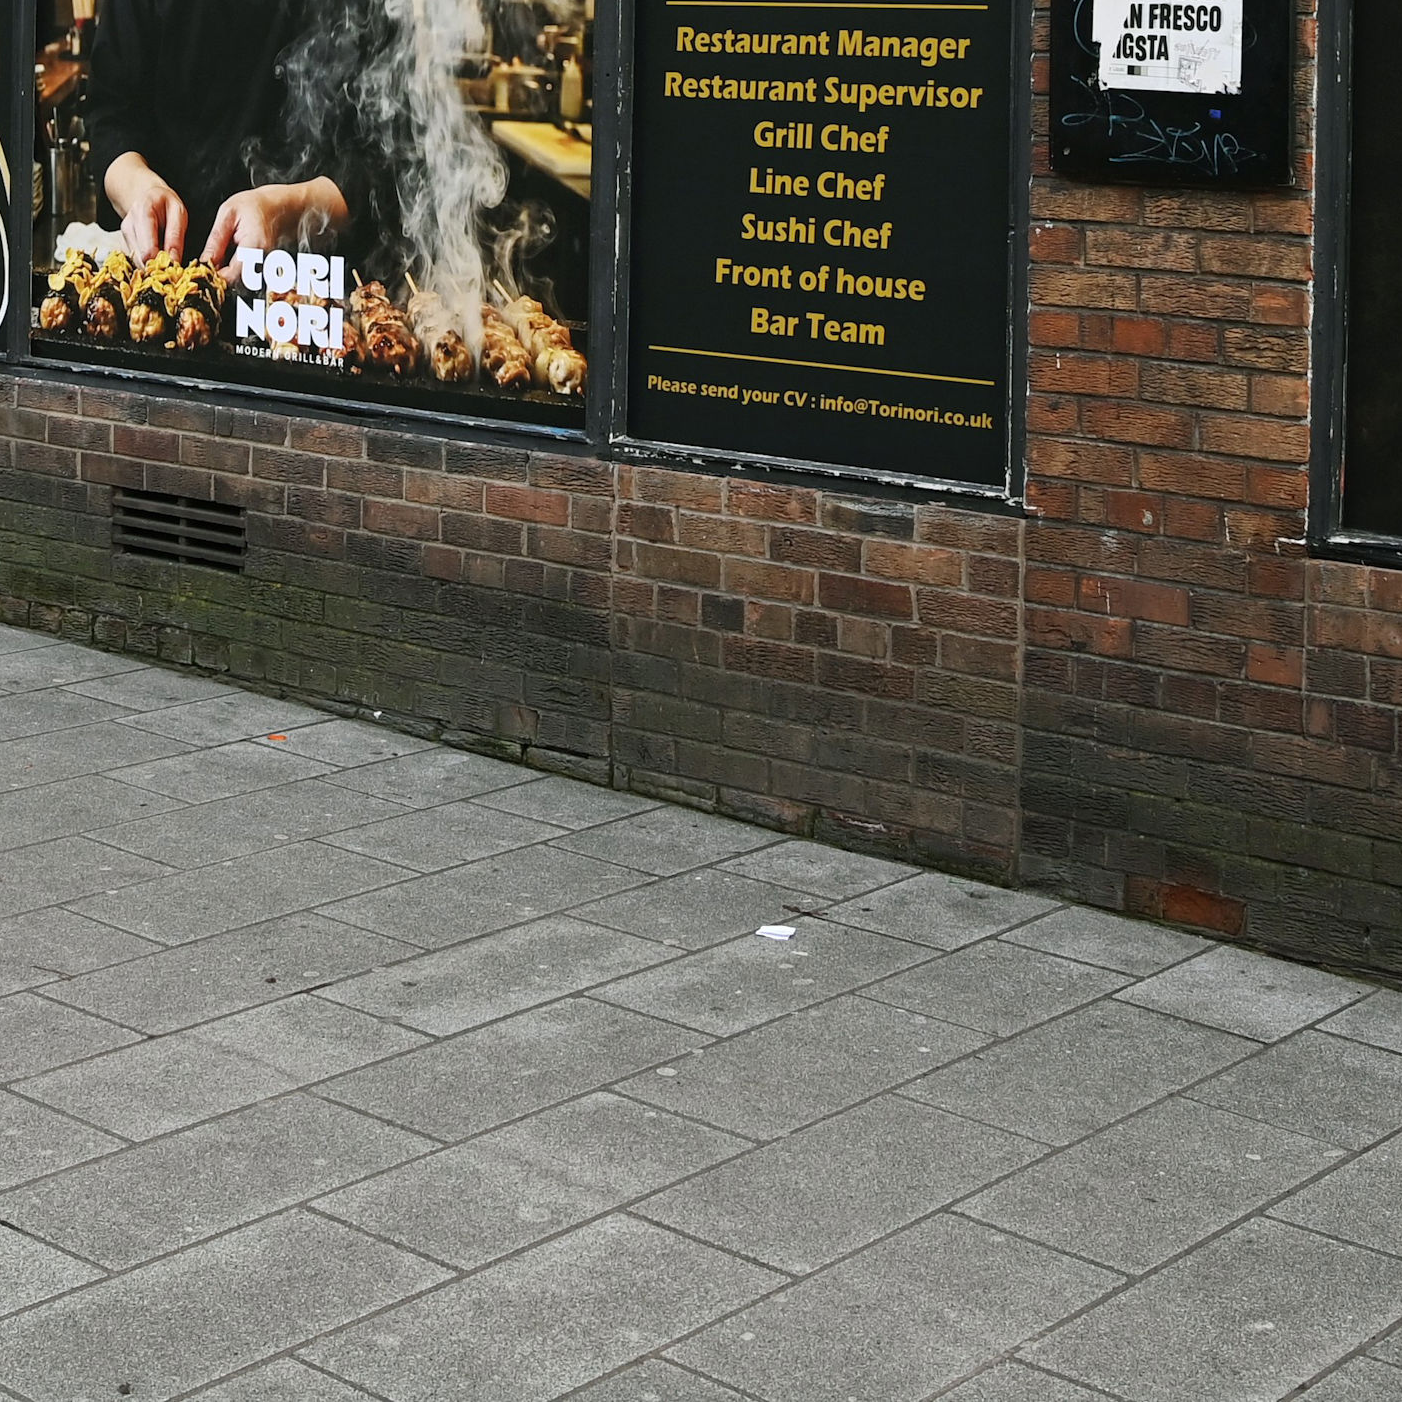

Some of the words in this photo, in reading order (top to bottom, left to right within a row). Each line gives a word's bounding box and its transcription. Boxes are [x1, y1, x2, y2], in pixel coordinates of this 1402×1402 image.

[1149, 4, 1222, 32] FRESCO
[676, 27, 830, 56] Restaurant
[837, 29, 970, 67] Manager
[664, 72, 816, 103] Restaurant
[824, 76, 983, 112] Supervisor
[753, 121, 813, 150] Grill
[820, 124, 889, 153] Chef
[749, 168, 808, 197] Line
[817, 172, 886, 201] Chef
[741, 213, 815, 244] Sushi
[823, 219, 893, 250] Chef
[237, 247, 345, 300] TORI
[715, 258, 792, 290] Front
[799, 266, 830, 292] of
[837, 267, 926, 301] house
[236, 295, 344, 349] NORI
[750, 307, 799, 336] Bar
[806, 312, 885, 346] Team
[235, 344, 278, 361] MODERN
[284, 350, 344, 368] GRILL&BAR
[647, 374, 697, 396] Please
[700, 381, 739, 400] send
[742, 388, 780, 407] your
[783, 389, 808, 408] CV
[820, 394, 993, 430] info@Torinori.co.uk
